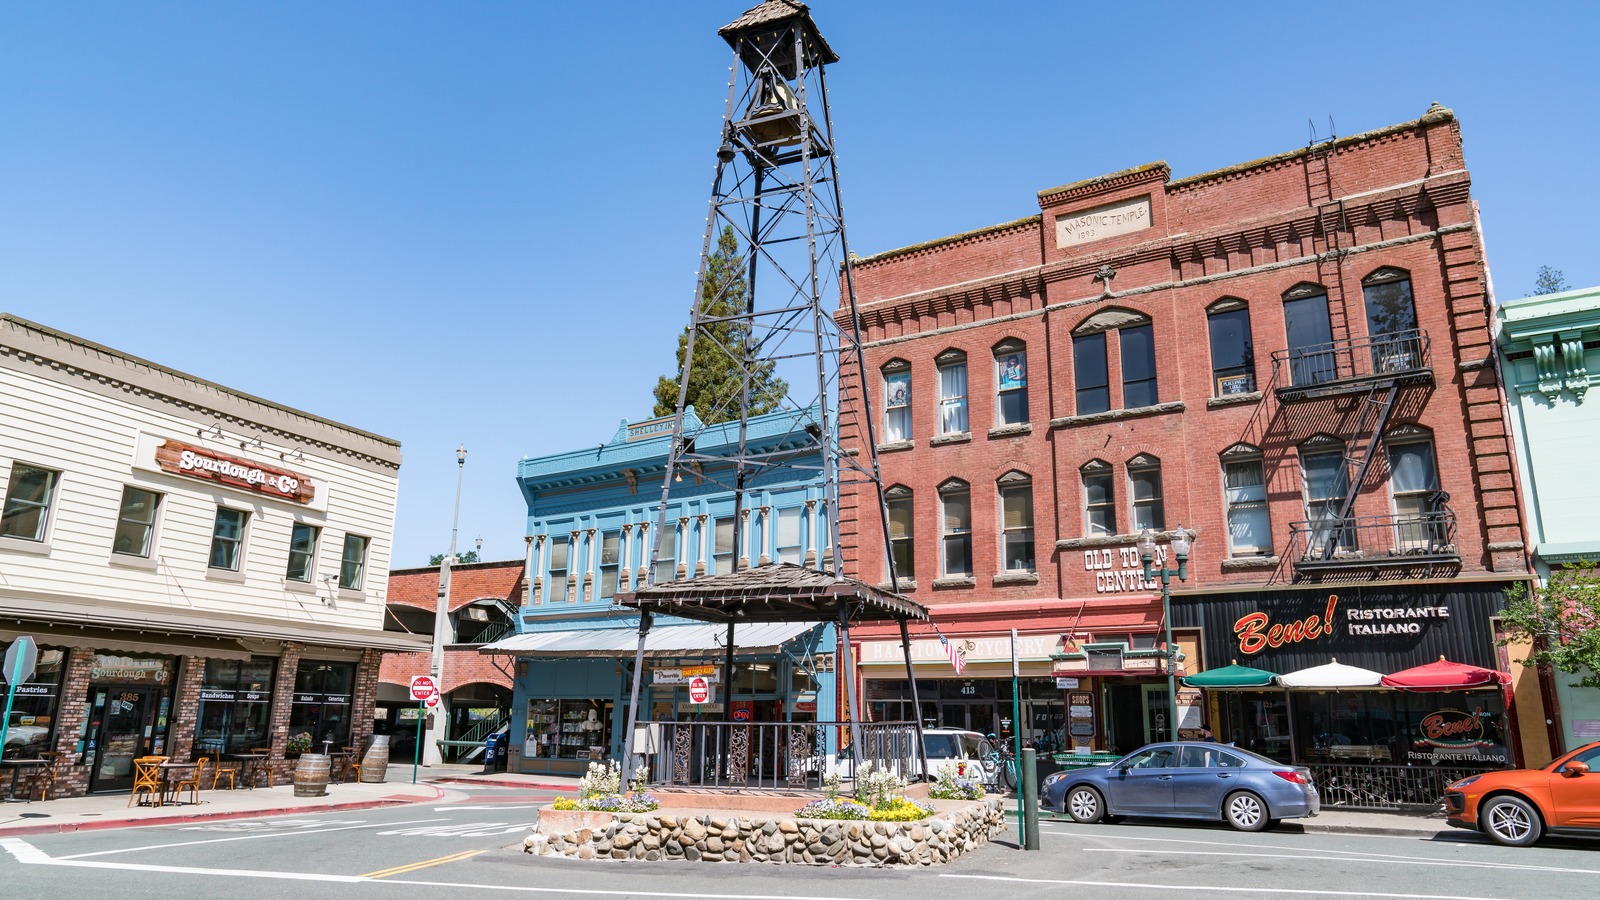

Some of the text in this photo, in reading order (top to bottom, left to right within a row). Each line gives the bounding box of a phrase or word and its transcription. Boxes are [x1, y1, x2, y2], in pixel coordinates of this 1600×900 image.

[1065, 215, 1108, 235] MASONIC
[630, 424, 663, 436] SHELLEY
[180, 450, 265, 485] Sourdough
[268, 476, 276, 486] &
[1084, 544, 1168, 570] OLD TON
[1347, 606, 1450, 620] RISTORANTE
[1234, 594, 1338, 655] Bene!
[1348, 622, 1421, 635] ITALIANO
[92, 667, 146, 680] Sourdough
[960, 686, 975, 694] 413
[120, 693, 139, 701] 385
[1072, 695, 1090, 704] SHOPS
[733, 711, 750, 719] OPEN
[1424, 706, 1480, 739] Bene!
[1407, 751, 1506, 762] RISTORANTE ITALIANO
